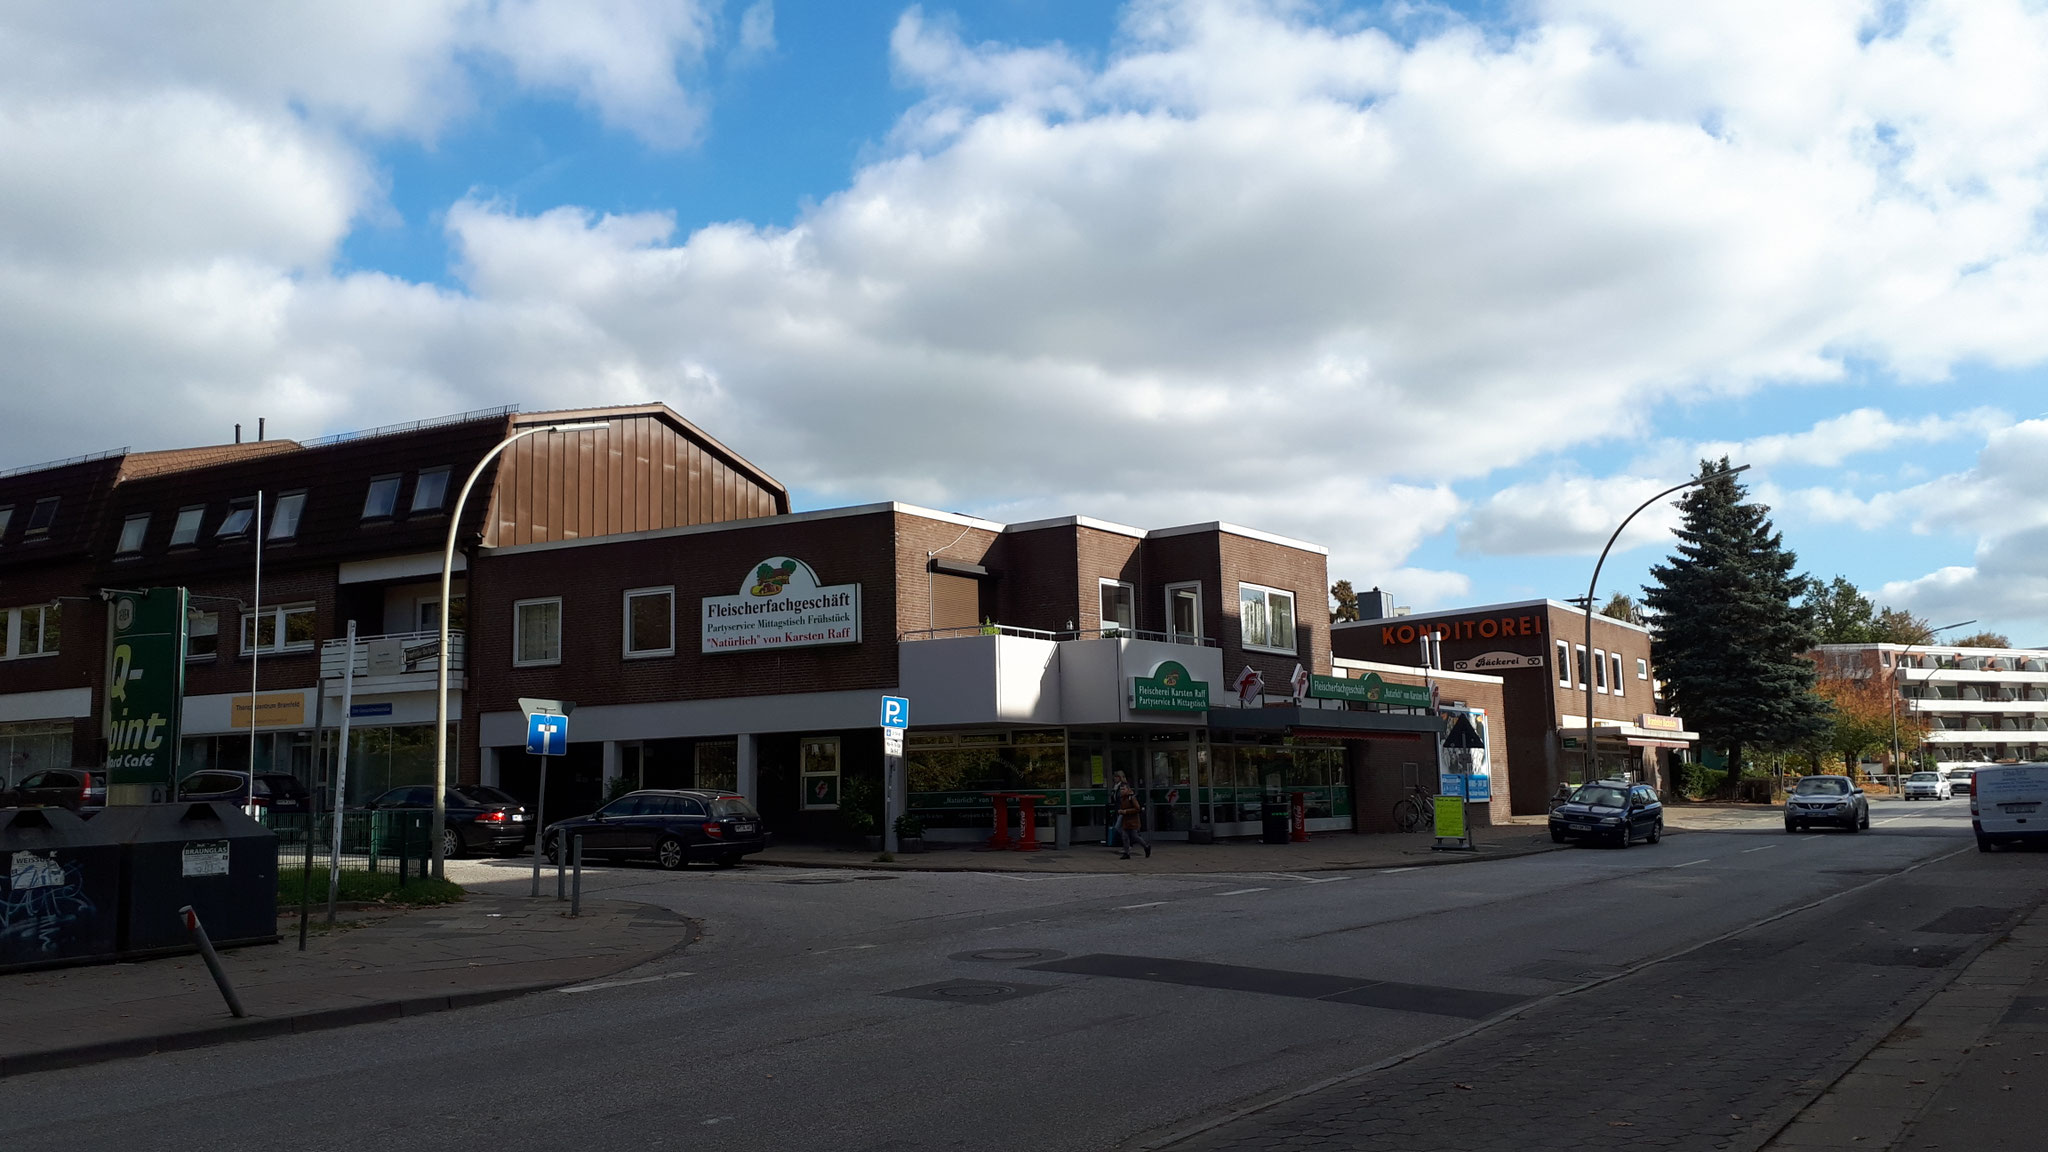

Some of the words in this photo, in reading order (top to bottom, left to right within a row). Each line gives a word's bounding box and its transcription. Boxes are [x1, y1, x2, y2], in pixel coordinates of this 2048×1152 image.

[708, 592, 850, 617] Fleischerfachgeschäft
[707, 622, 755, 634] Partyservice
[758, 616, 805, 630] Mittagstisch
[808, 612, 850, 625] Frühstück
[1382, 616, 1542, 645] KONDITOREI
[707, 634, 760, 648] "Natürlich"
[763, 635, 782, 644] von
[785, 631, 824, 643] Karsten
[828, 627, 851, 639] Raff
[1475, 657, 1519, 668] Bäckerei
[1139, 686, 1170, 696] Fleischerei
[1171, 688, 1193, 697] Karsten
[1194, 689, 1206, 698] Raff
[1314, 680, 1365, 696] Fleischerfachgeschäft
[236, 702, 277, 711] Therapzentrum
[1139, 696, 1170, 707] Partyservice
[1177, 698, 1206, 709] Mittagstisch
[885, 700, 901, 723] P
[109, 707, 167, 751] oint
[124, 753, 155, 767] Café
[185, 846, 227, 855] BRAUNGLAS
